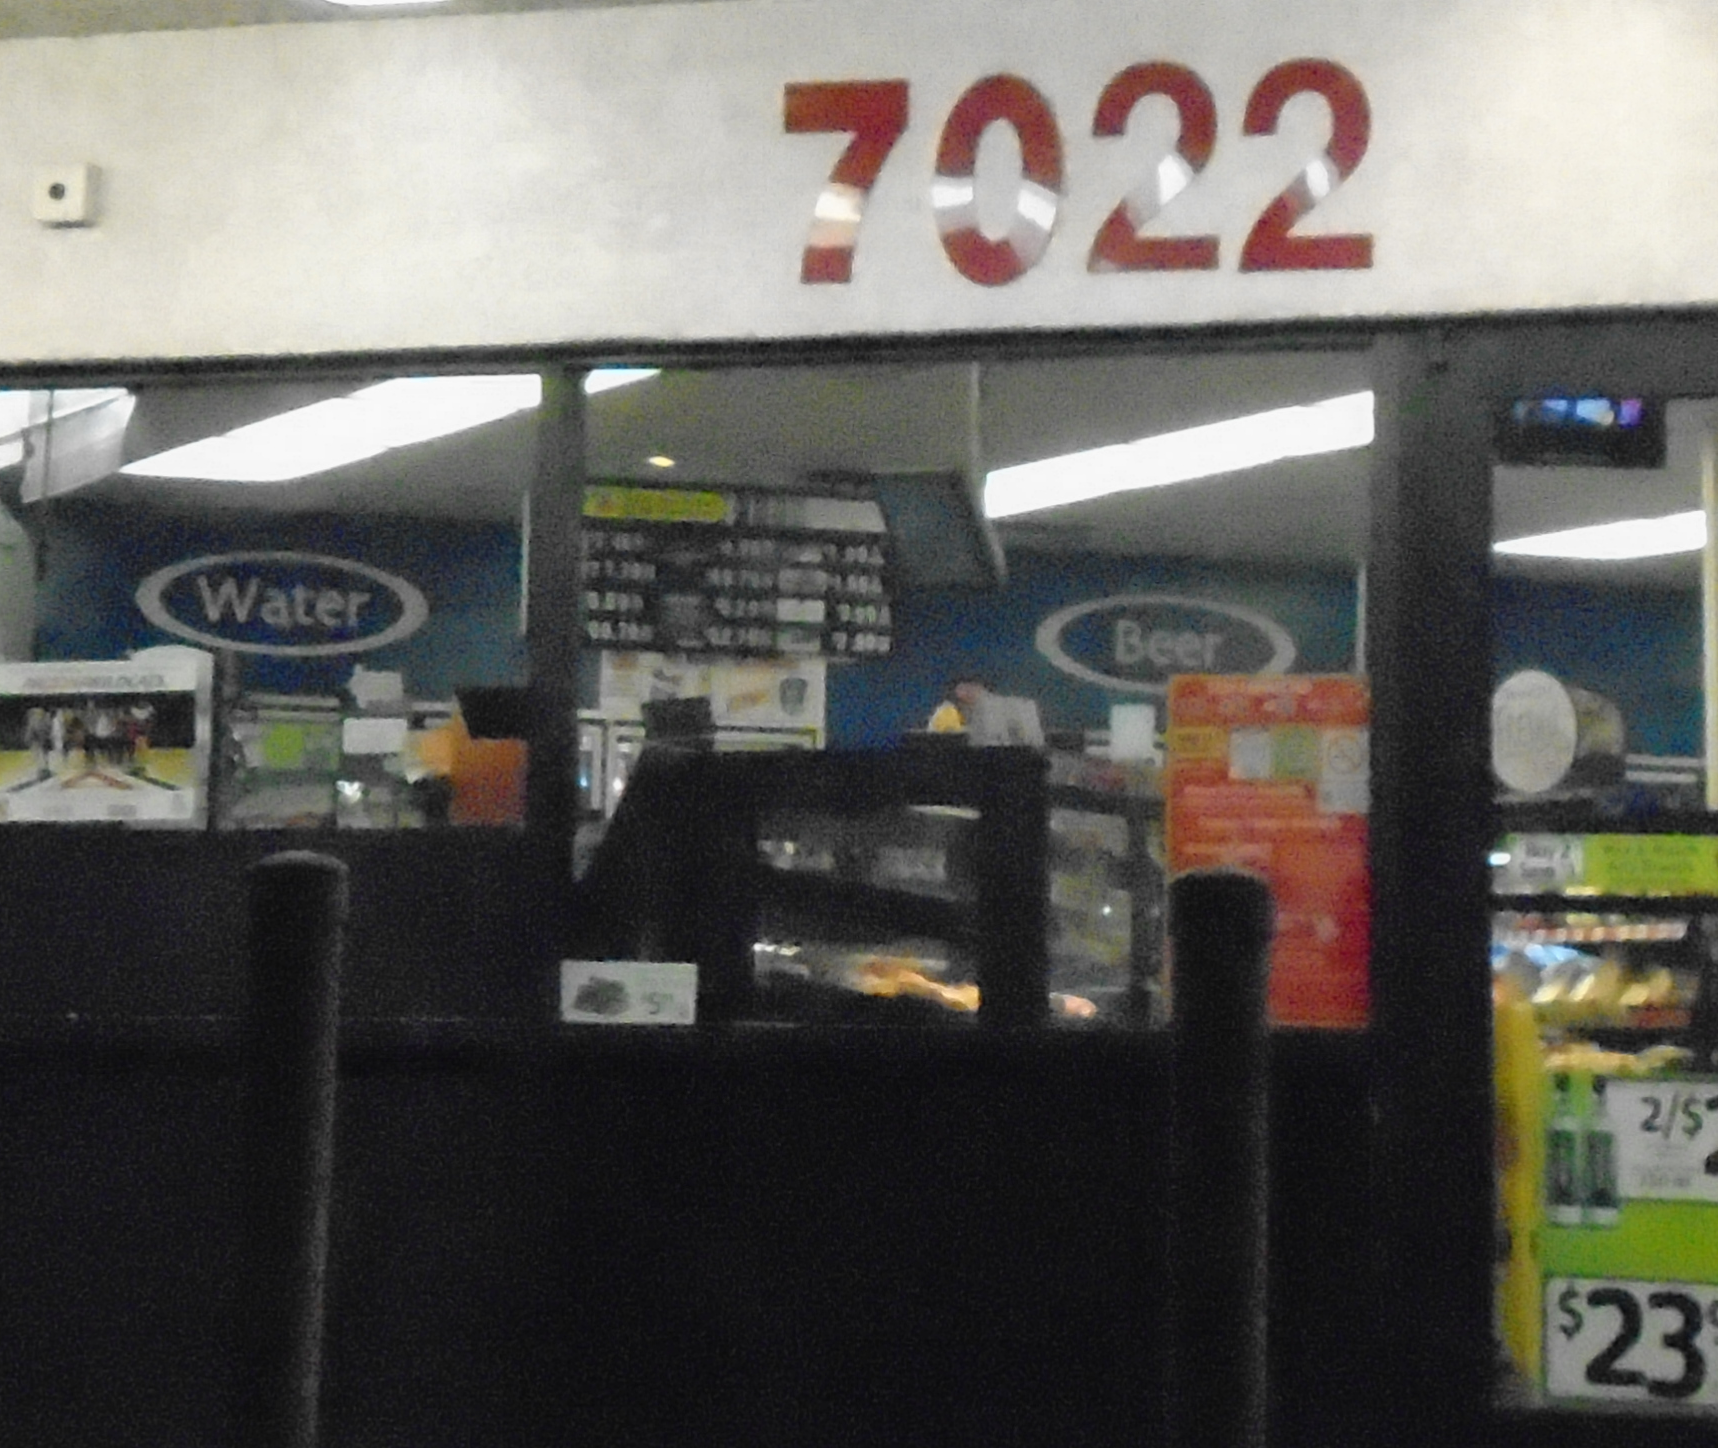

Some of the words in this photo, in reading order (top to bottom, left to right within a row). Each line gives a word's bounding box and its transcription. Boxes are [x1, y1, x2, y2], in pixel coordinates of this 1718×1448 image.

[781, 56, 1375, 288] 7022
[195, 572, 373, 631] Water
[1114, 617, 1225, 670] Beer
